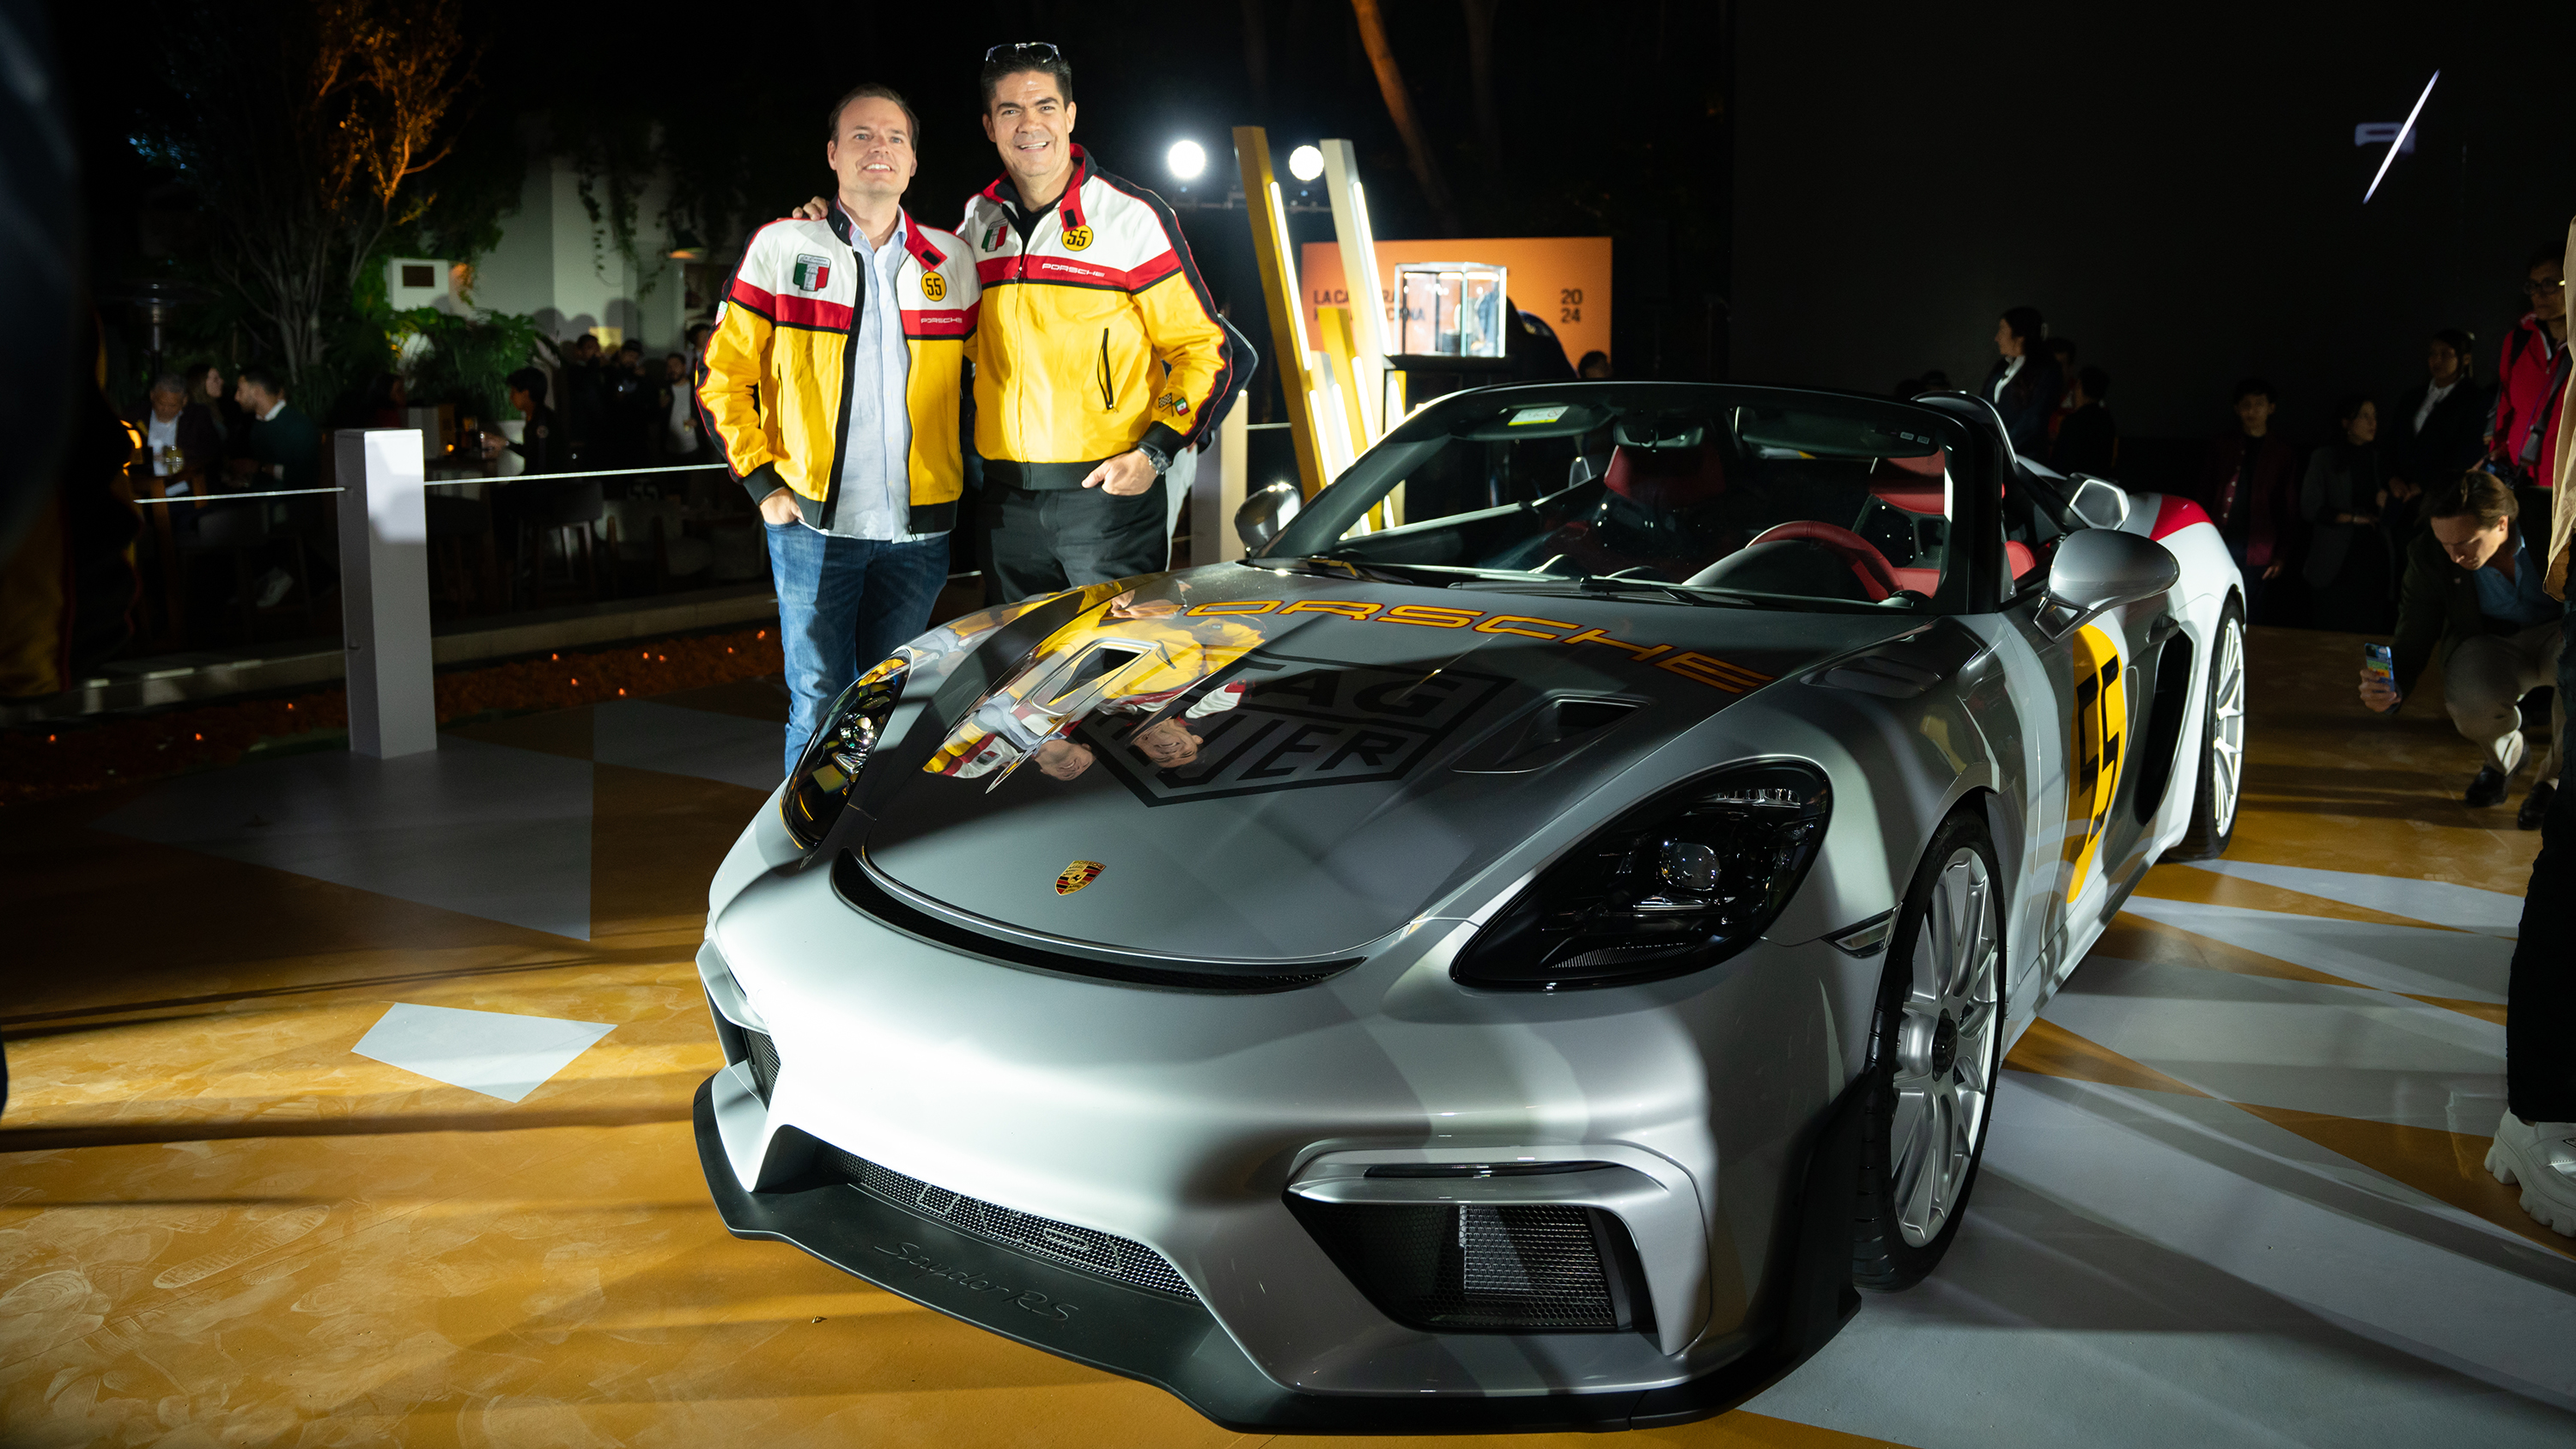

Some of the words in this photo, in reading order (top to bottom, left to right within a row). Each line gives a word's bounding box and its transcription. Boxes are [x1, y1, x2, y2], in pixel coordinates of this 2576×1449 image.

[1066, 228, 1088, 247] 55
[1042, 262, 1106, 277] PORSCHE
[925, 277, 943, 297] 55
[1313, 289, 1332, 305] LA
[1560, 289, 1583, 306] 20
[1560, 307, 1582, 324] 24
[2068, 654, 2120, 863] 55
[873, 1240, 1010, 1295] Spyder
[1001, 1288, 1079, 1322] RS
